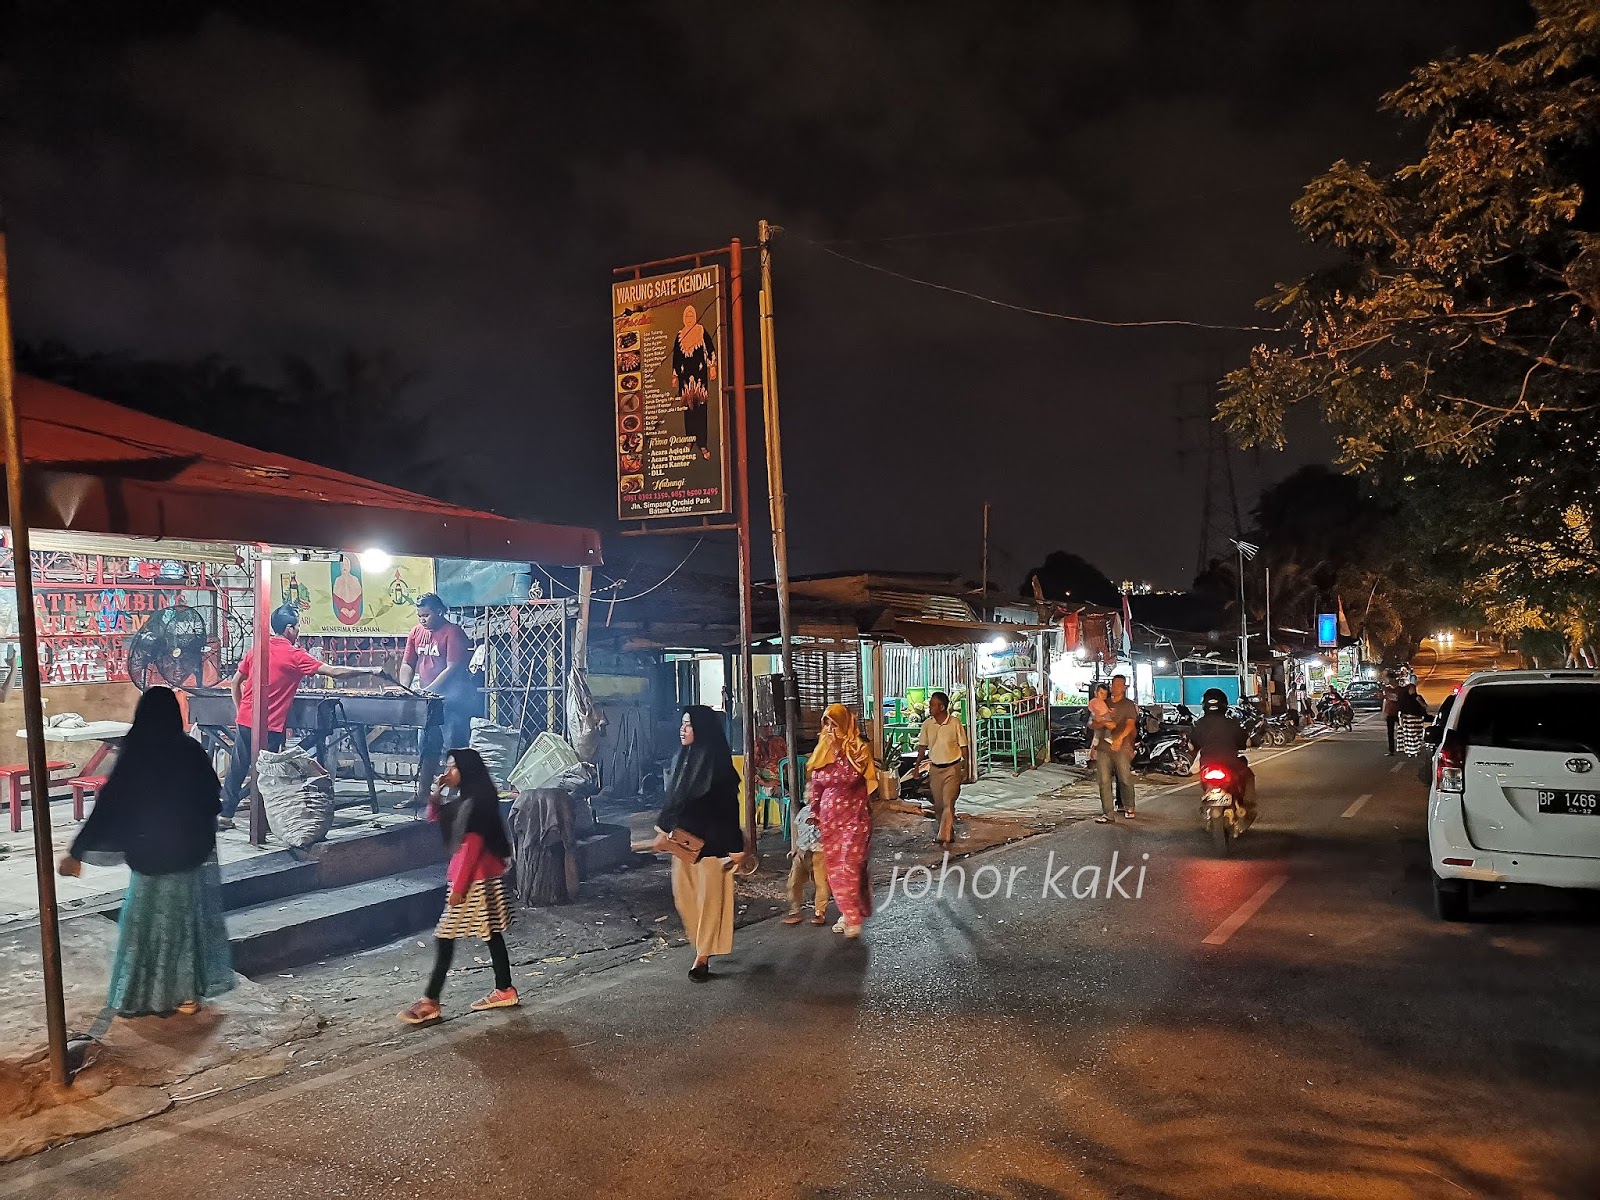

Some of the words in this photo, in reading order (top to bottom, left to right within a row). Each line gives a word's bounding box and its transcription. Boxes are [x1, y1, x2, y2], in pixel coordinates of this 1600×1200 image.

[616, 282, 653, 304] WARUNG
[655, 279, 677, 298] SATE
[669, 454, 697, 462] Tumpeng
[651, 462, 668, 470] Acara
[643, 500, 671, 509] Simpang
[672, 498, 694, 506] Orchid
[695, 496, 711, 504] Park
[649, 507, 670, 515] Batam
[670, 505, 692, 513] Center
[34, 592, 77, 612] ATE
[84, 592, 188, 613] KAMBING
[36, 614, 77, 634] ATE
[352, 625, 380, 633] PESANAN
[39, 663, 90, 684] YAM
[1539, 791, 1555, 806] BP
[1565, 793, 1596, 808] 1466
